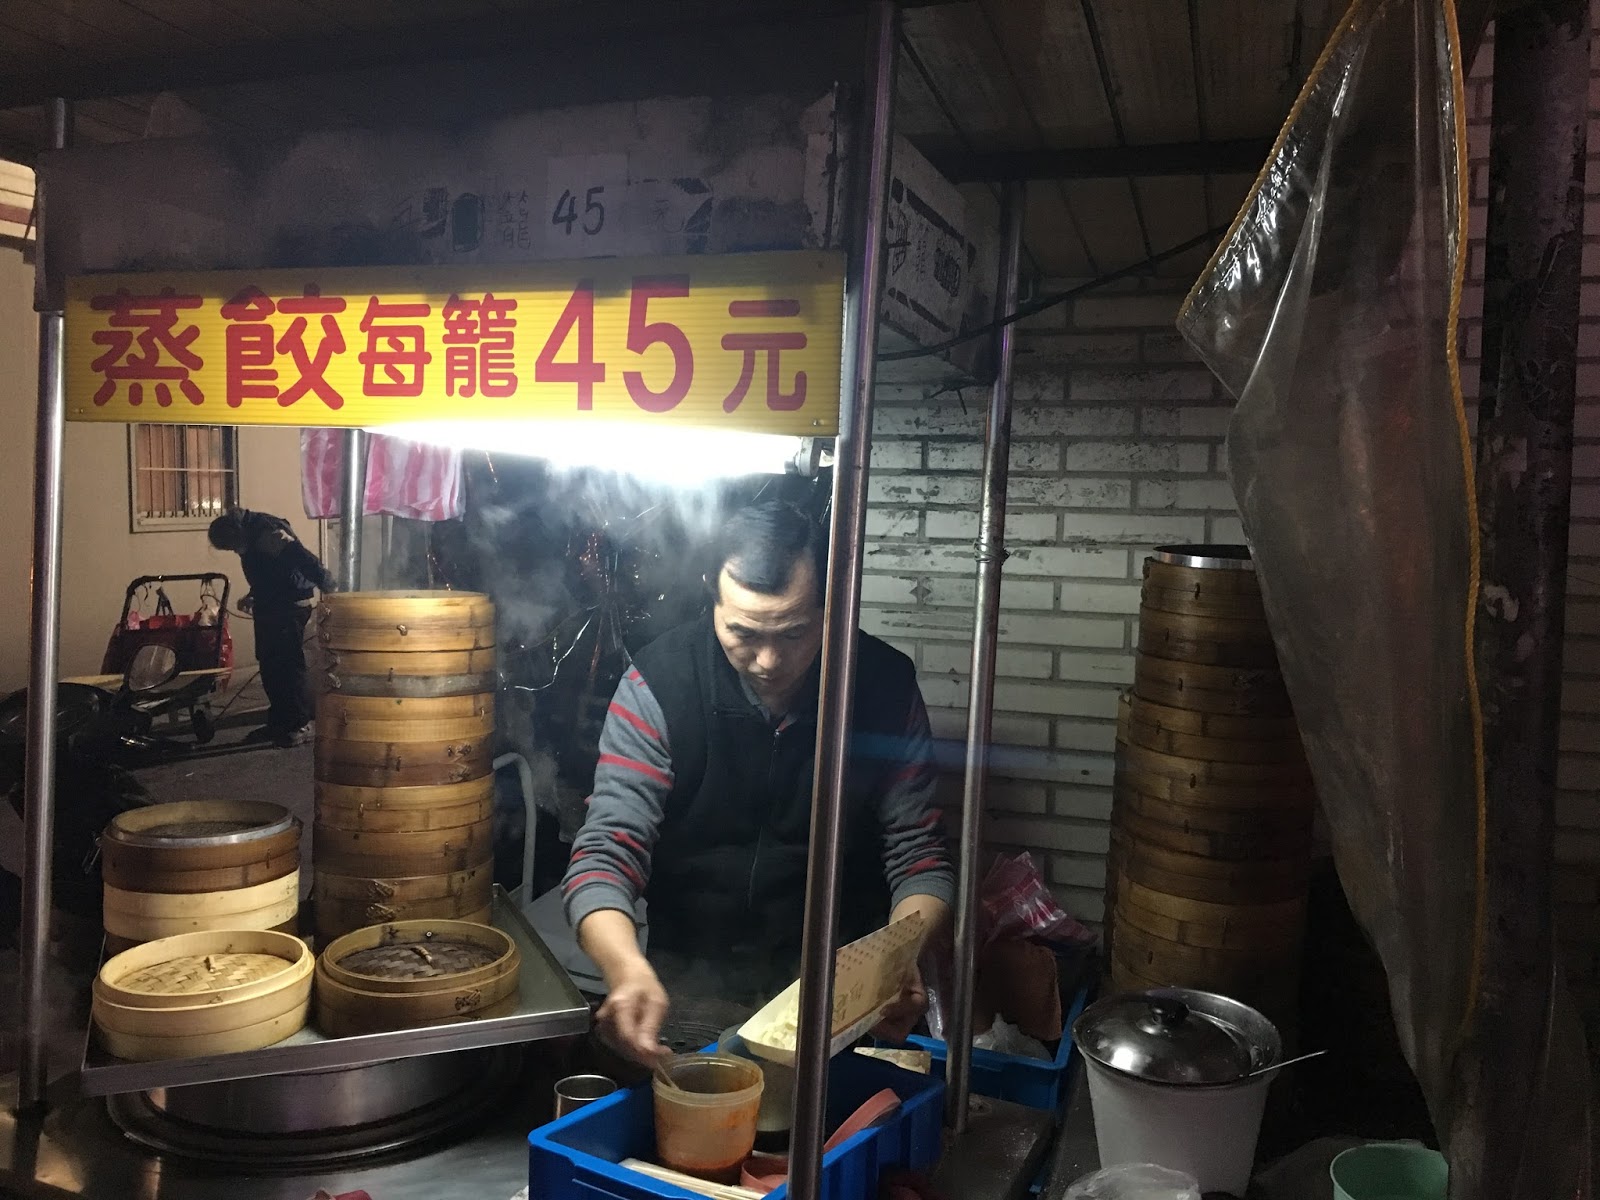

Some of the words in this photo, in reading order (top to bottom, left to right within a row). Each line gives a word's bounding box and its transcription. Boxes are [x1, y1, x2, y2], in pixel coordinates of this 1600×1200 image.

[552, 186, 605, 236] 45
[91, 273, 808, 413] 蒸餃每籠45元
